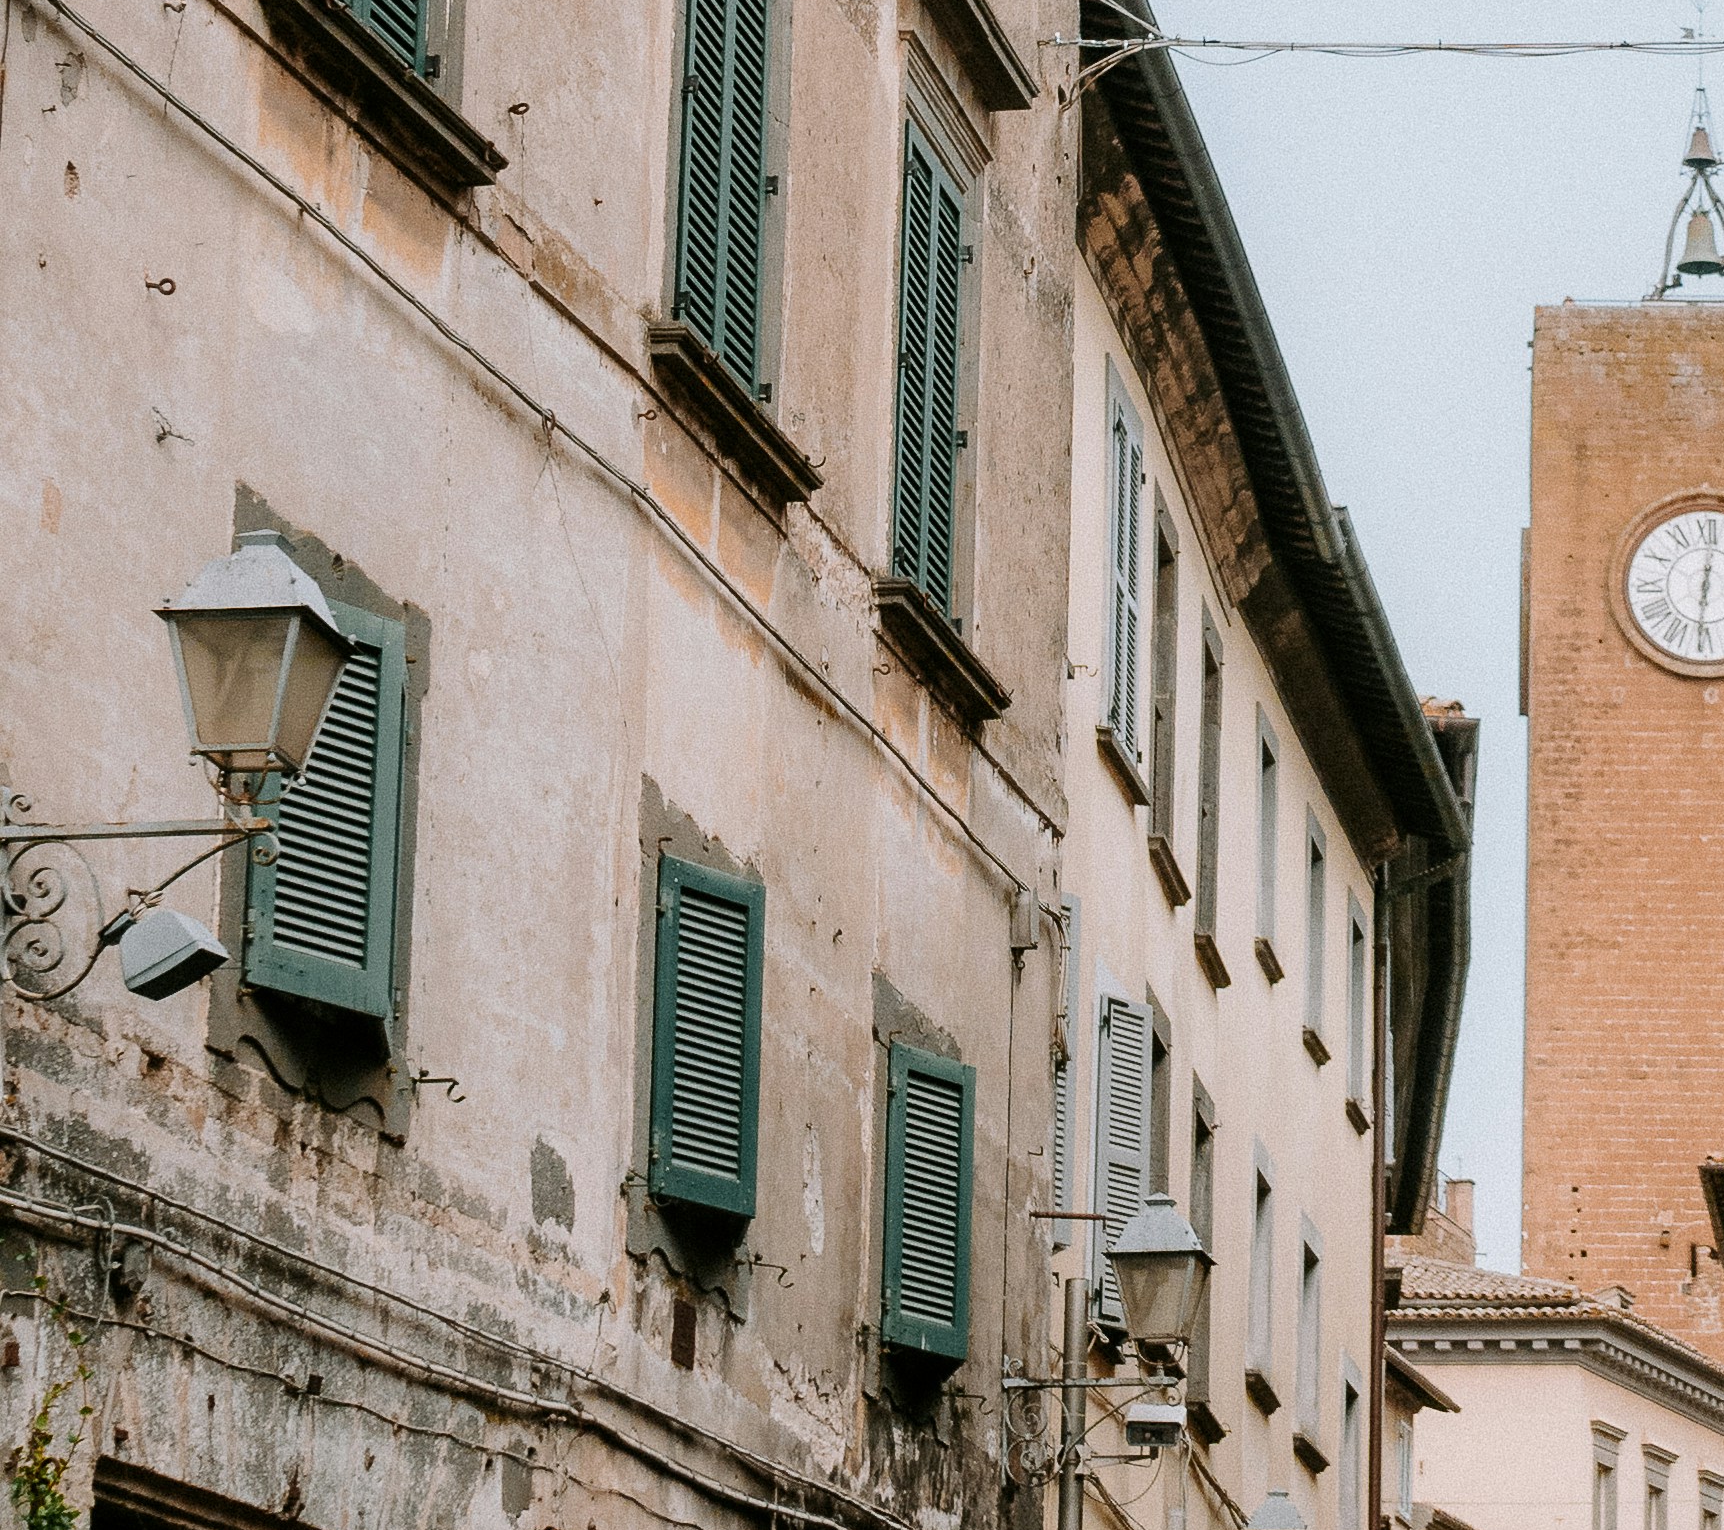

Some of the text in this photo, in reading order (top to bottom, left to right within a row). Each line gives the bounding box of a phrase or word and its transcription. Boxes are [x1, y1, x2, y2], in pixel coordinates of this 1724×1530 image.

[1665, 524, 1690, 549] XI
[1696, 519, 1717, 545] XII
[1644, 550, 1671, 569] X
